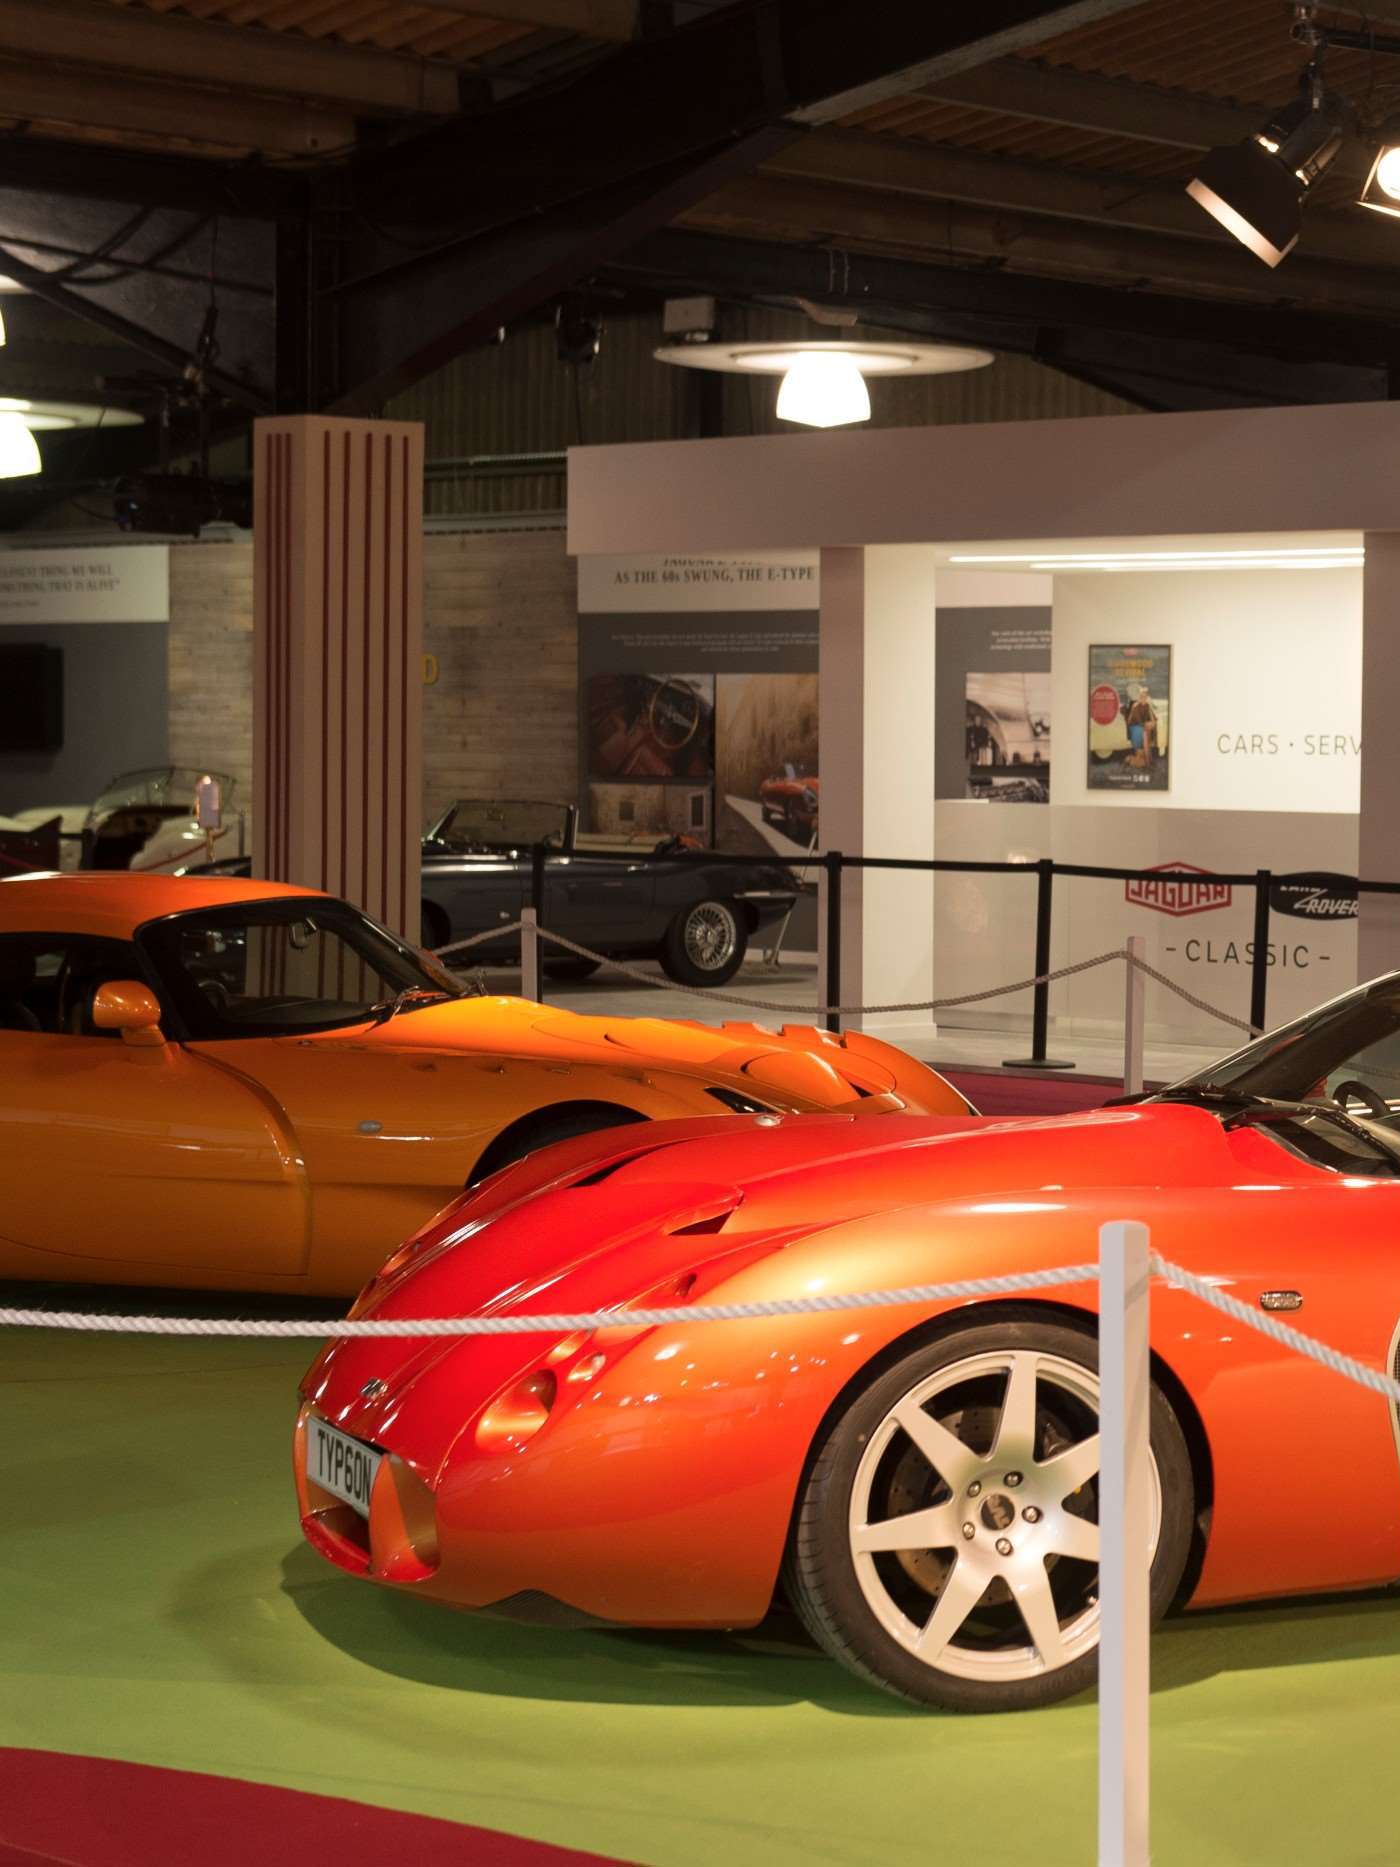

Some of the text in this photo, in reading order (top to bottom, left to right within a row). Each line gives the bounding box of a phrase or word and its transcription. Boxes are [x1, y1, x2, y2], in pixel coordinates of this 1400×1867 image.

[614, 570, 630, 584] AS
[634, 570, 656, 584] THE
[684, 568, 734, 584] SWUNG,
[739, 568, 761, 582] THE
[768, 567, 812, 581] E-TYPE
[1217, 734, 1279, 754] CARS
[1304, 734, 1362, 755] SERV
[1130, 870, 1226, 908] JAGUAR
